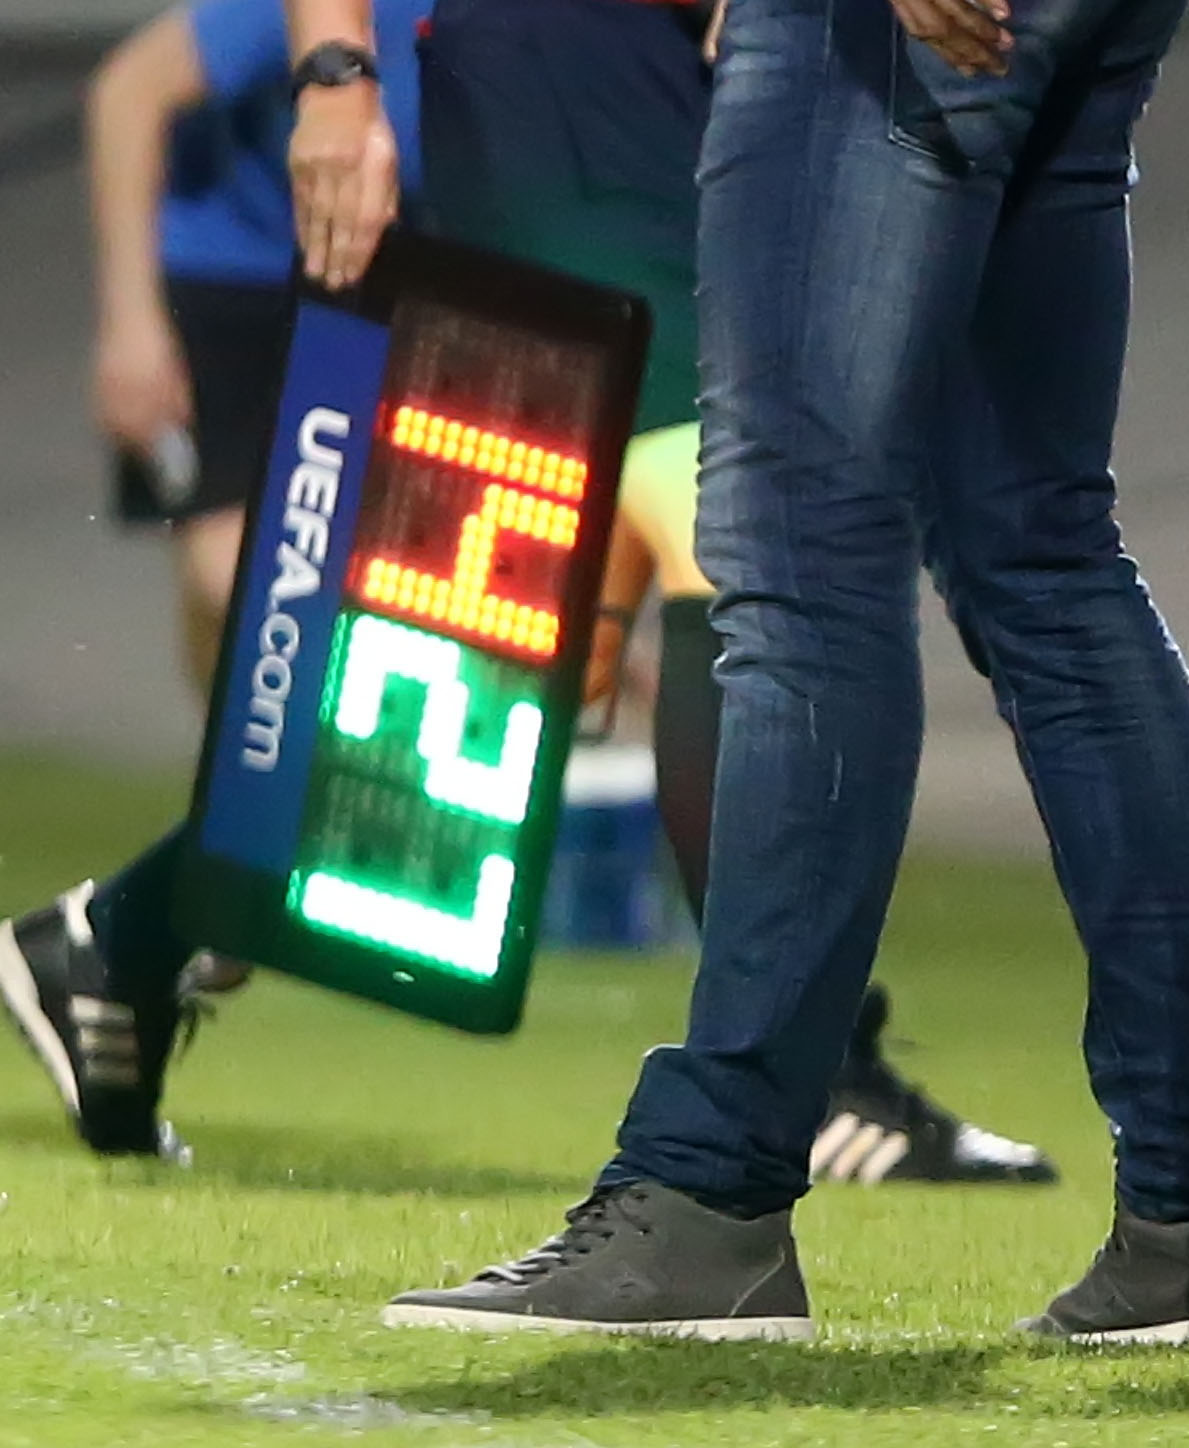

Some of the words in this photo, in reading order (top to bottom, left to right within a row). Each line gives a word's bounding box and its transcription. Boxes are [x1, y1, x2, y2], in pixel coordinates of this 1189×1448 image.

[239, 406, 351, 773] UEFA.com
[364, 405, 588, 658] 14
[300, 613, 543, 979] 27
